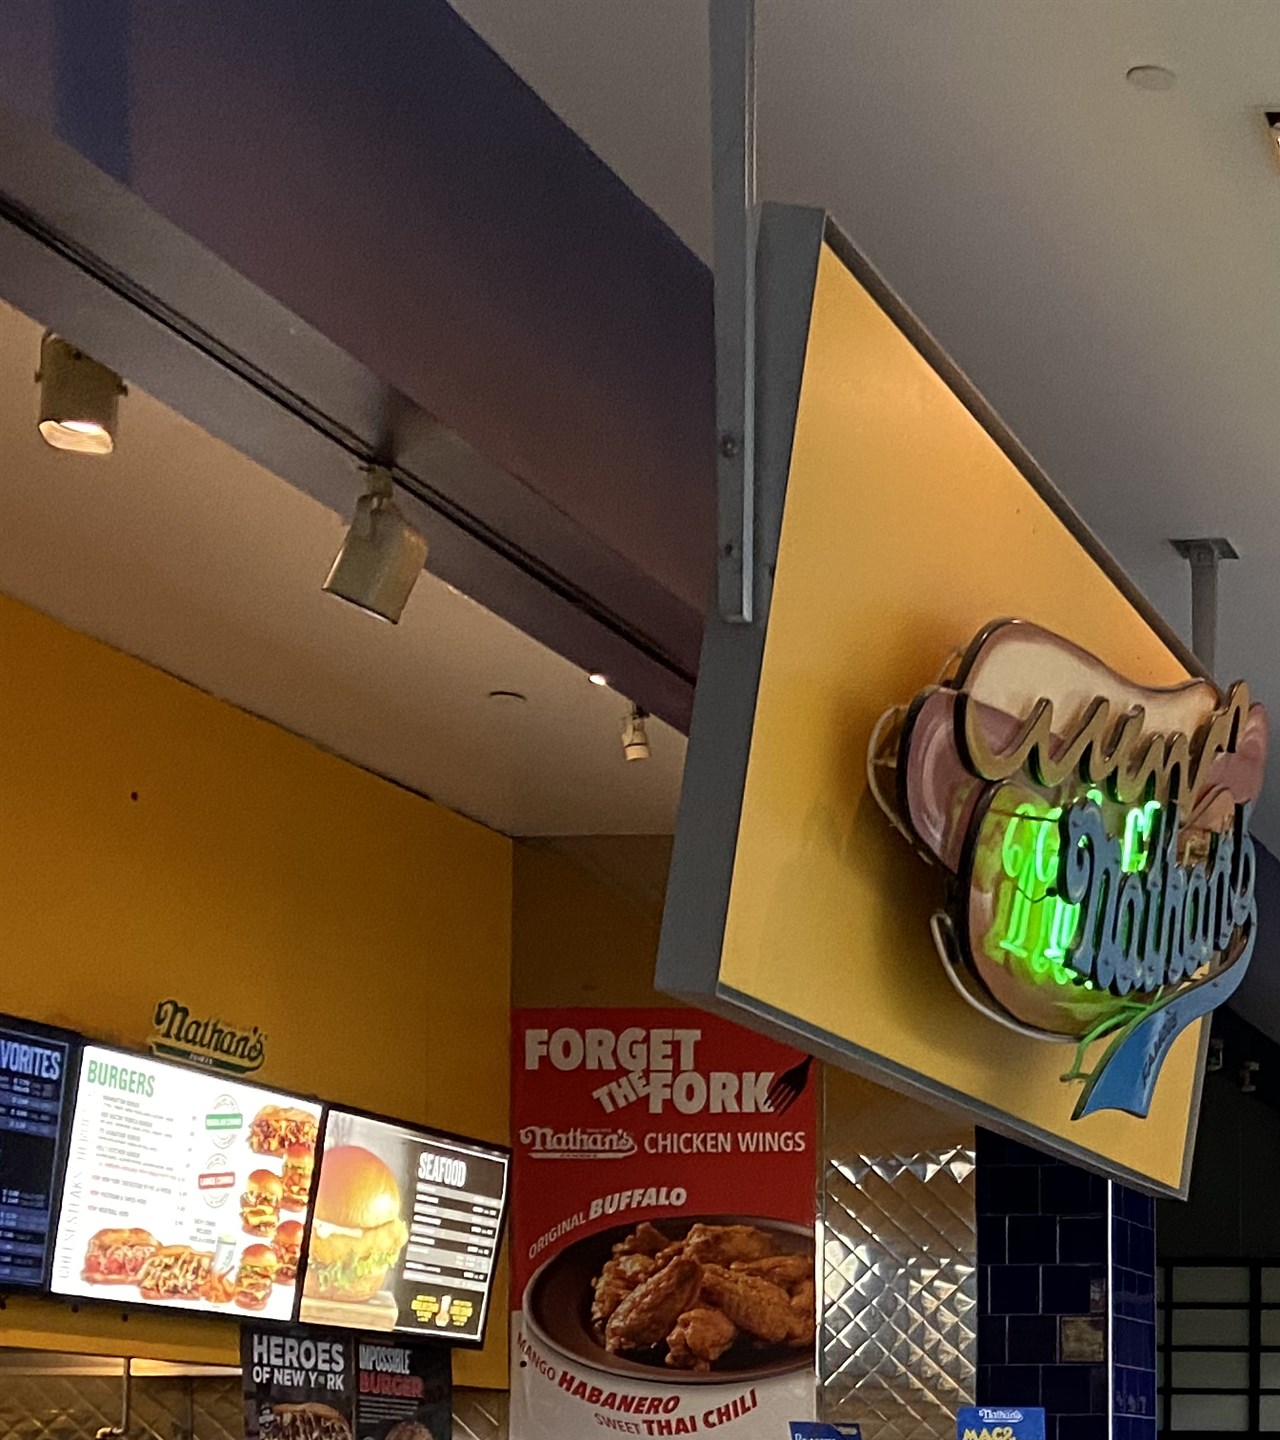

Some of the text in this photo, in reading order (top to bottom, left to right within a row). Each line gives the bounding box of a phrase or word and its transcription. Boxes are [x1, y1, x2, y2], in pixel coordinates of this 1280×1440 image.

[154, 999, 265, 1063] Nathan's
[525, 1028, 701, 1071] FORGET
[87, 1060, 155, 1098] BURGERS
[592, 1069, 651, 1114] THE
[649, 1071, 776, 1114] FORK
[519, 1126, 807, 1154] Nathan's CHICKEN WINGS
[418, 1152, 467, 1188] SEAFOOD
[528, 1187, 688, 1260] ORIGINAL BUFFALO
[253, 1334, 345, 1373] HEROES
[359, 1344, 414, 1374] IMPOSSIBLE
[516, 1333, 681, 1415] MANGO HABANERO
[252, 1366, 271, 1384] OF
[273, 1369, 305, 1387] NEW
[359, 1369, 425, 1398] BURGER
[594, 1387, 758, 1437] SWEET THAI CHILI
